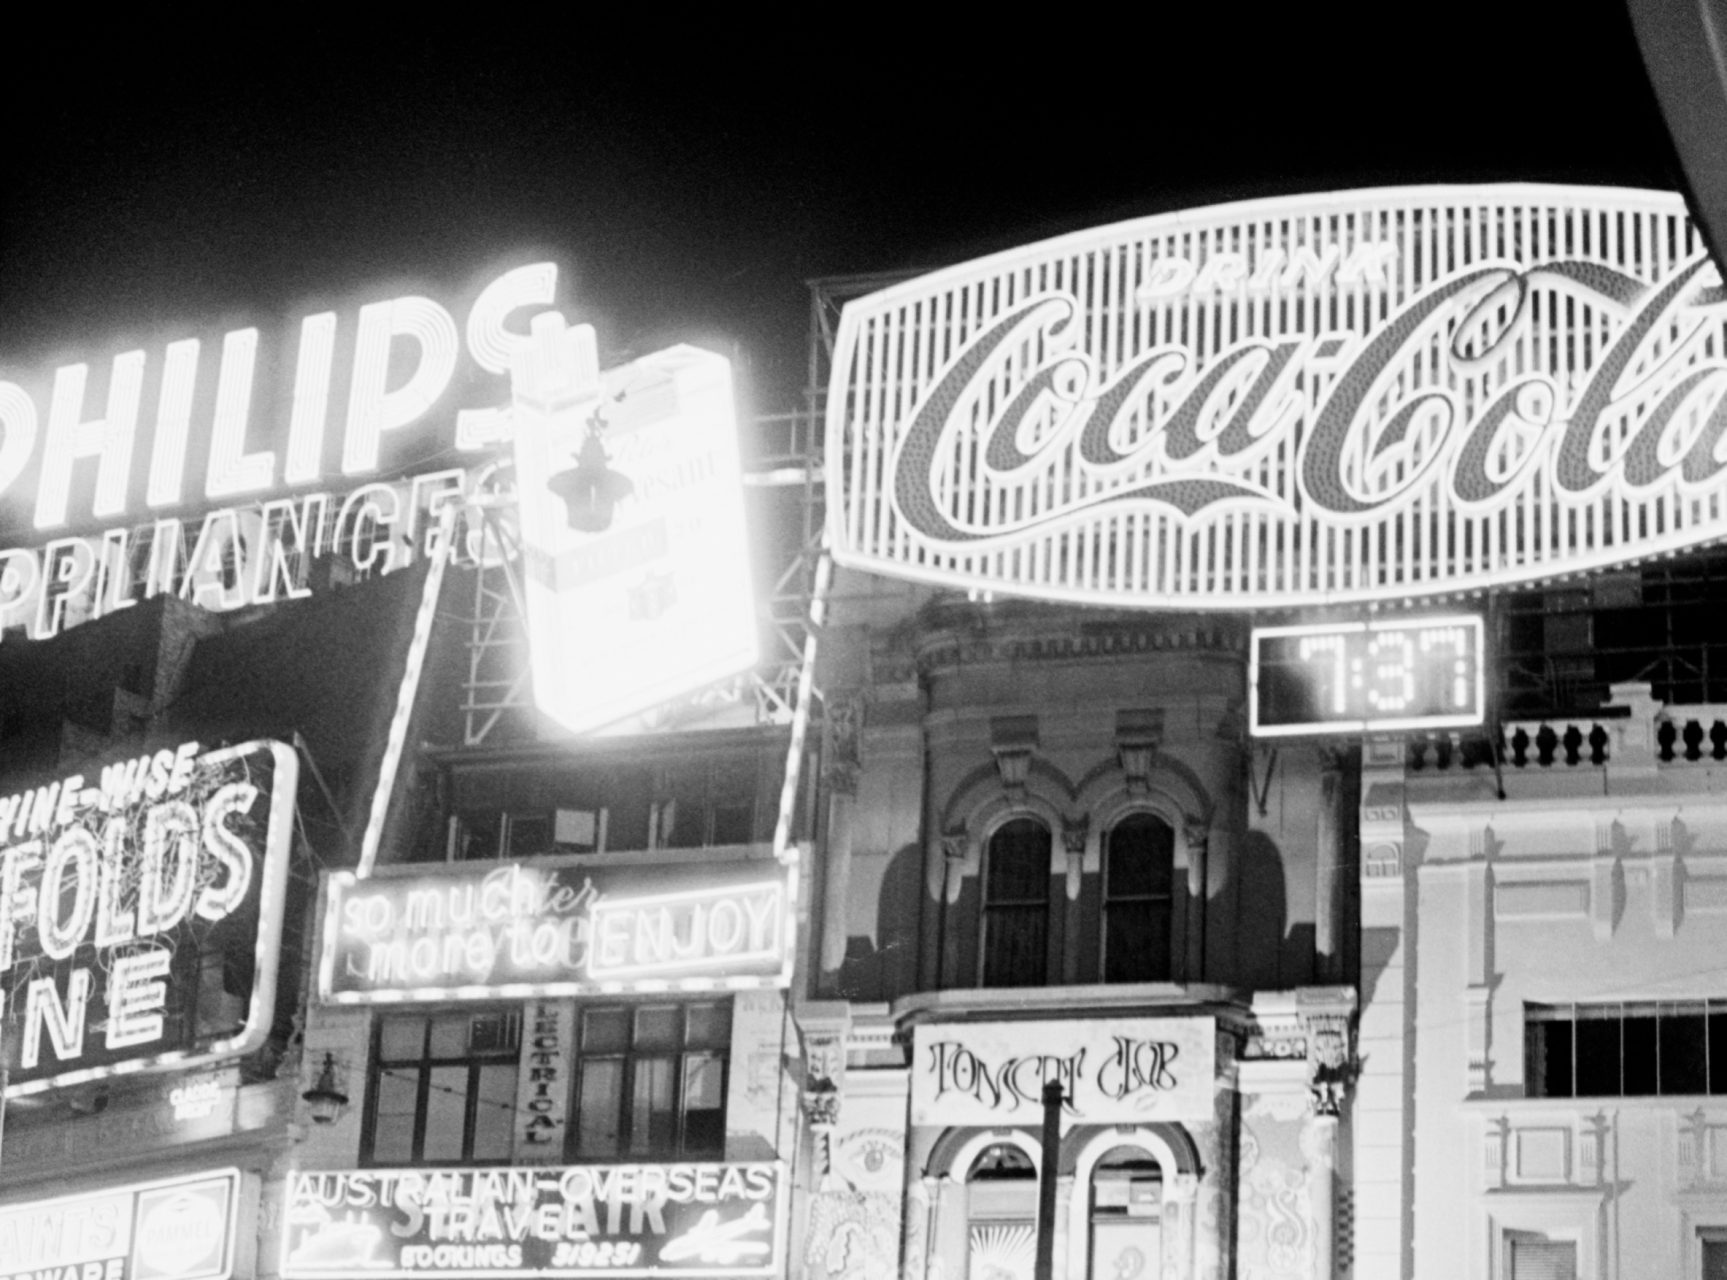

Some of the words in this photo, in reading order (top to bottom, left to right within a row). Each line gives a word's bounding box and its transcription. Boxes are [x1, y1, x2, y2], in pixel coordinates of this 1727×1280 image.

[1134, 240, 1397, 298] DRINK
[888, 249, 1727, 553] Coca-Cola
[1300, 627, 1466, 713] 7:37
[342, 893, 392, 936] so
[405, 863, 538, 930] much
[599, 895, 776, 966] ENJOY
[368, 930, 492, 981] more
[504, 910, 560, 967] to
[0, 950, 171, 1069] NE
[1097, 1035, 1179, 1101] CLUB
[0, 1203, 120, 1265] AINTS
[401, 1245, 522, 1267] BOOKINGS
[422, 1203, 591, 1241] TRAVEL
